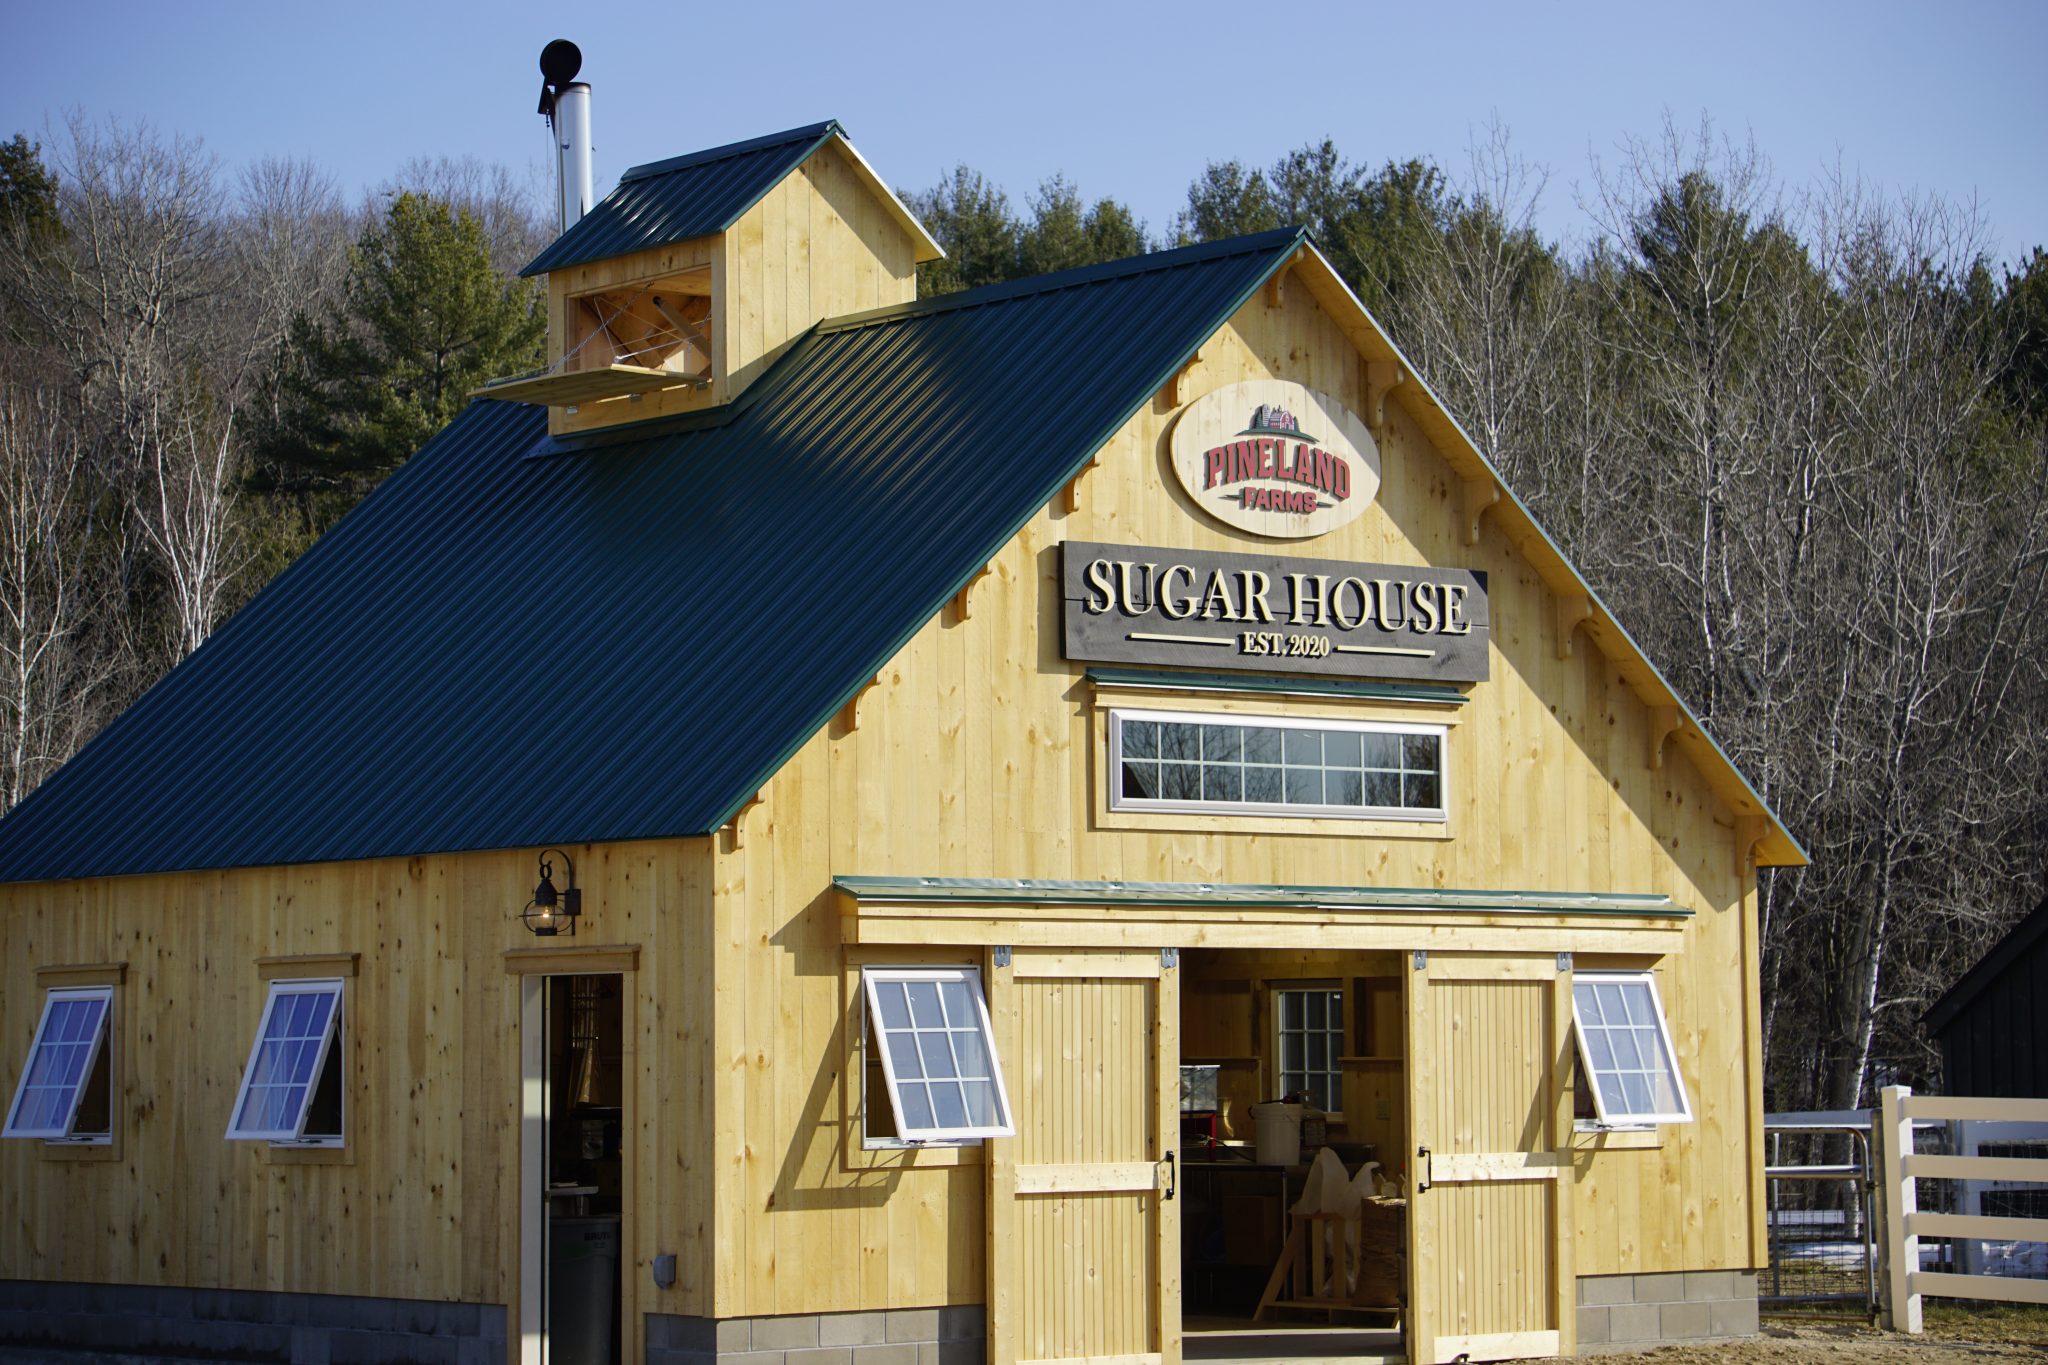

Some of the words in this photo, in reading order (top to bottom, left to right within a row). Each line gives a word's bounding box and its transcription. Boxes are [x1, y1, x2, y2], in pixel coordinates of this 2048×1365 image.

[1207, 438, 1351, 500] PINELAND
[1242, 487, 1317, 513] FARMS
[1088, 558, 1276, 622] SUGAR
[1289, 573, 1472, 634] HOUSE
[1243, 631, 1287, 655] EST.
[1290, 634, 1330, 657] 2020
